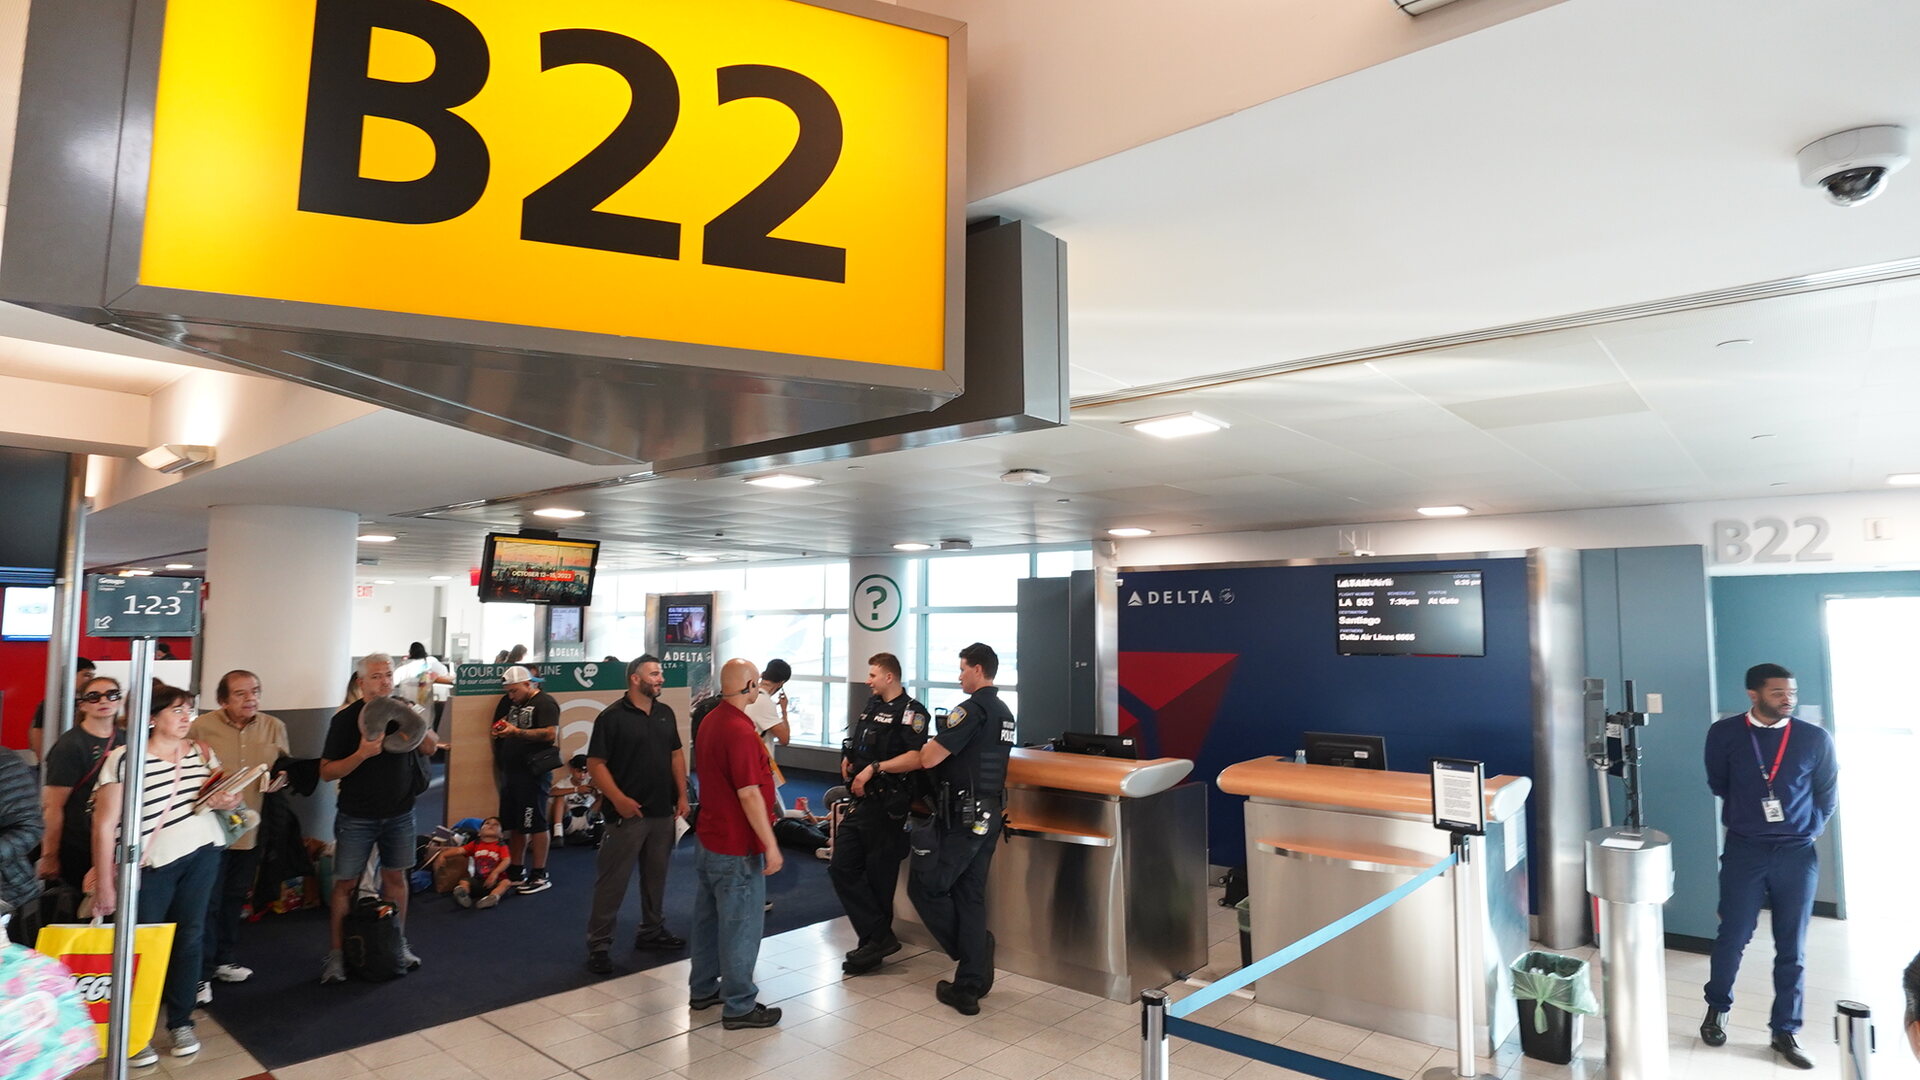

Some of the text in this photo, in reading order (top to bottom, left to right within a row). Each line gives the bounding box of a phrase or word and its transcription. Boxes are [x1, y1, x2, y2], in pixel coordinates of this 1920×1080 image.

[296, 0, 846, 284] B22
[1713, 516, 1834, 564] B22
[356, 585, 374, 598] EXIT
[1147, 590, 1214, 604] DELTA
[122, 595, 181, 616] 1-2-3
[1339, 598, 1374, 606] LA 533
[1427, 597, 1460, 605] At Gate
[1338, 616, 1381, 626] Santiago
[1373, 633, 1395, 641] Lines
[555, 648, 579, 657] DELTA
[672, 652, 704, 662] DELTA
[460, 666, 494, 678] YOUR
[539, 665, 562, 676] LINE
